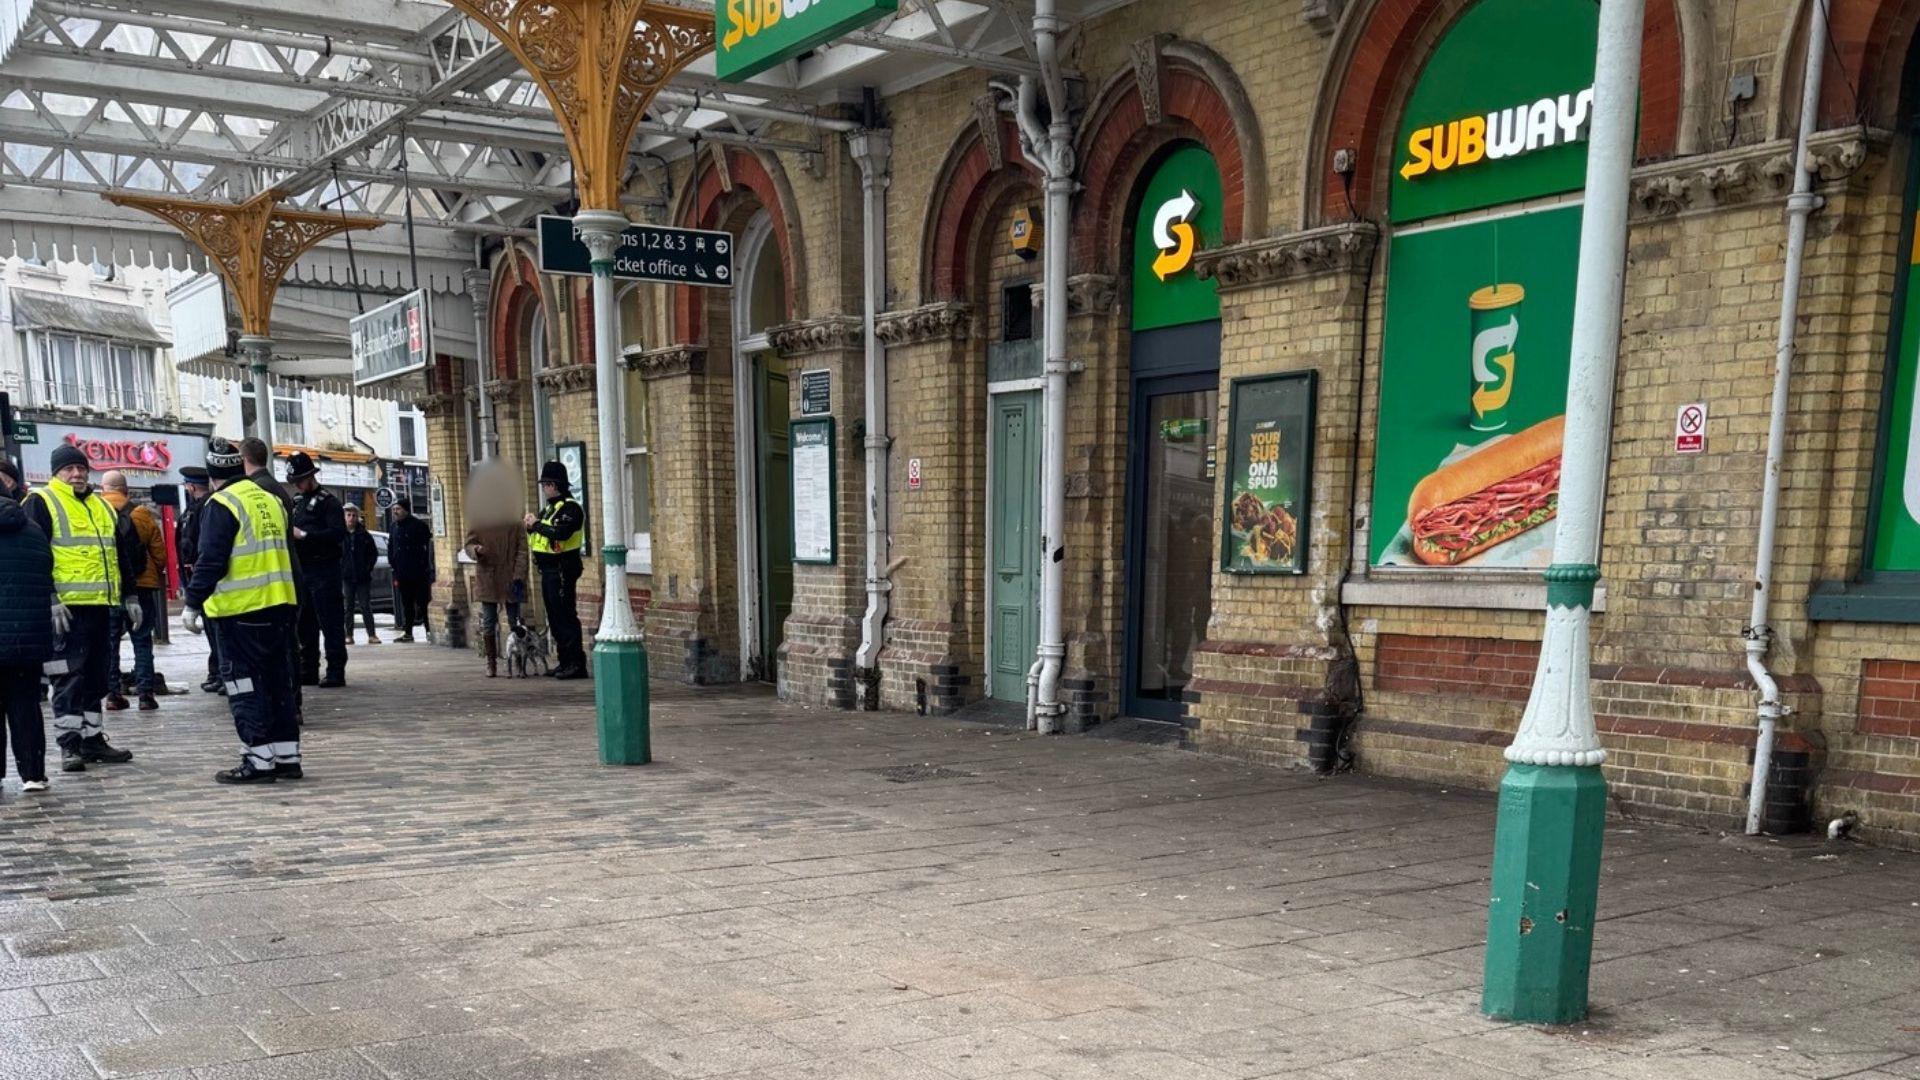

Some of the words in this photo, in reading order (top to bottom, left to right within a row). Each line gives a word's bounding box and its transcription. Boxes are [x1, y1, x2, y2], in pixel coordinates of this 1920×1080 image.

[1400, 83, 1594, 181] SUBWAY
[663, 235, 675, 249] &
[677, 236, 687, 250] 3
[613, 256, 645, 273] icket
[649, 259, 688, 276] office
[1251, 431, 1281, 445] YOUR
[1250, 446, 1279, 462] SUB
[1249, 463, 1267, 476] ON
[1268, 463, 1279, 476] A
[1248, 477, 1277, 489] SPUD
